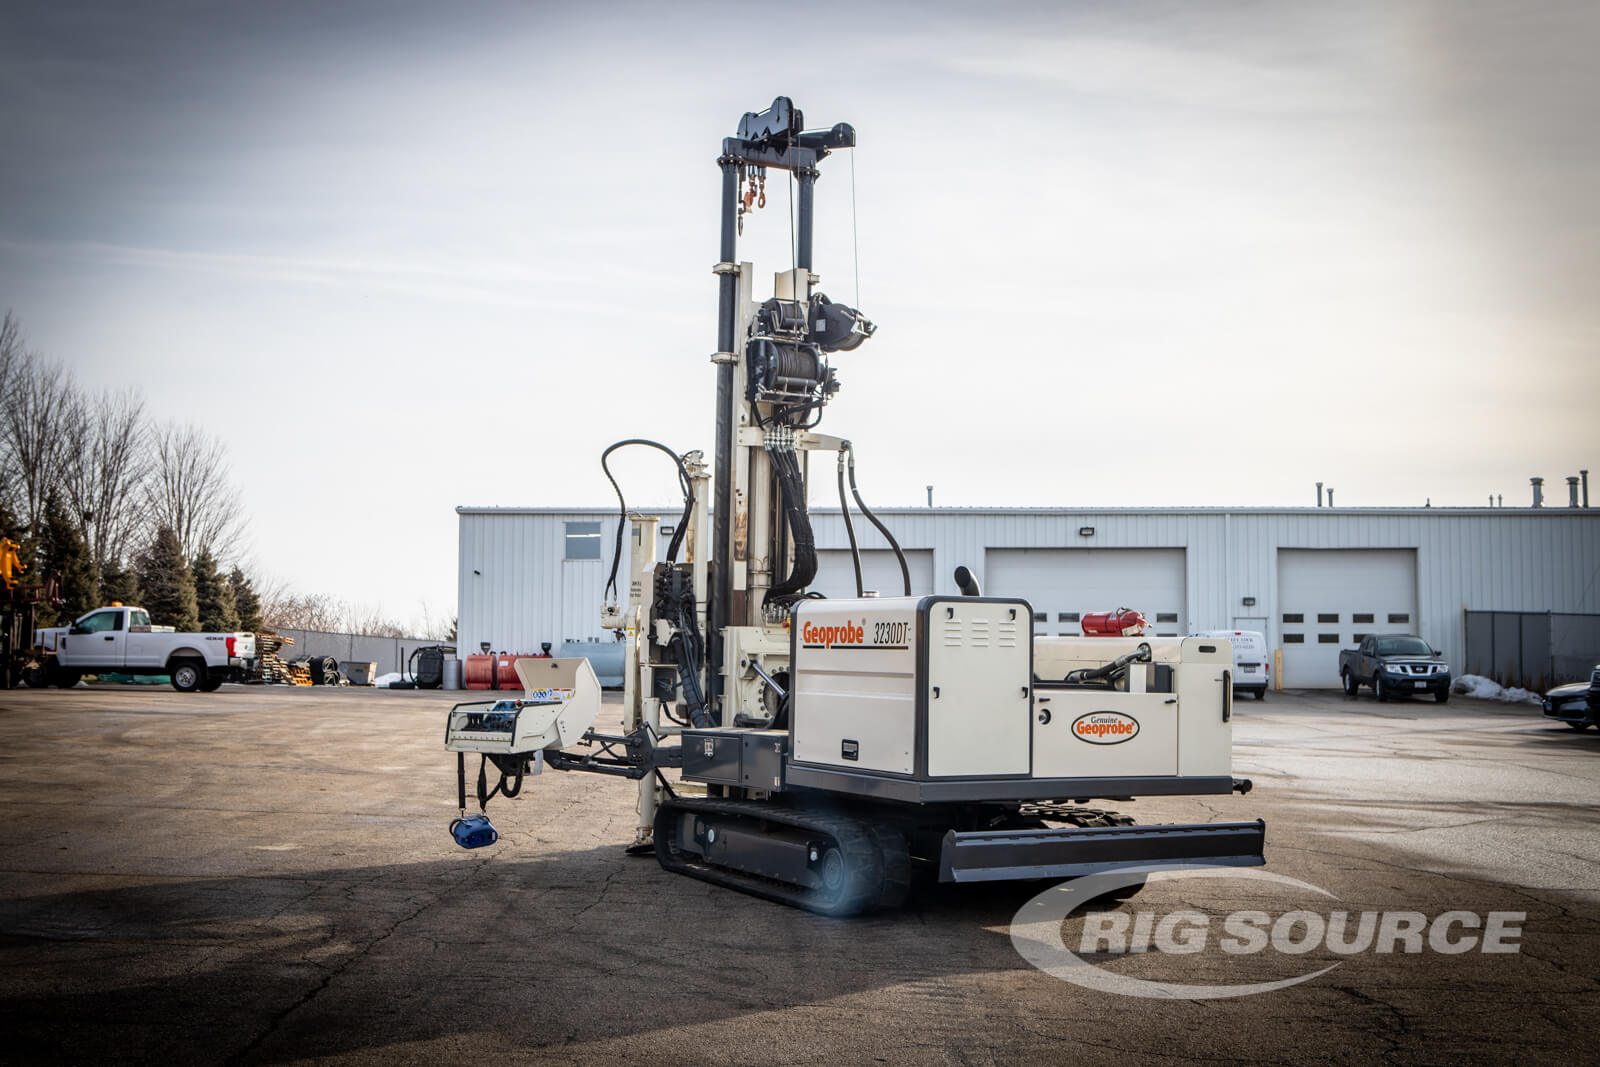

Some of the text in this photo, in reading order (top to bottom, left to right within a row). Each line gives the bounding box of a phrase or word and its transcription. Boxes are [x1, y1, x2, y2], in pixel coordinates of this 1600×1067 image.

[803, 620, 908, 648] Geoprobe 3230DT
[1090, 715, 1118, 724] Genuine
[1076, 720, 1133, 738] Geoprobe
